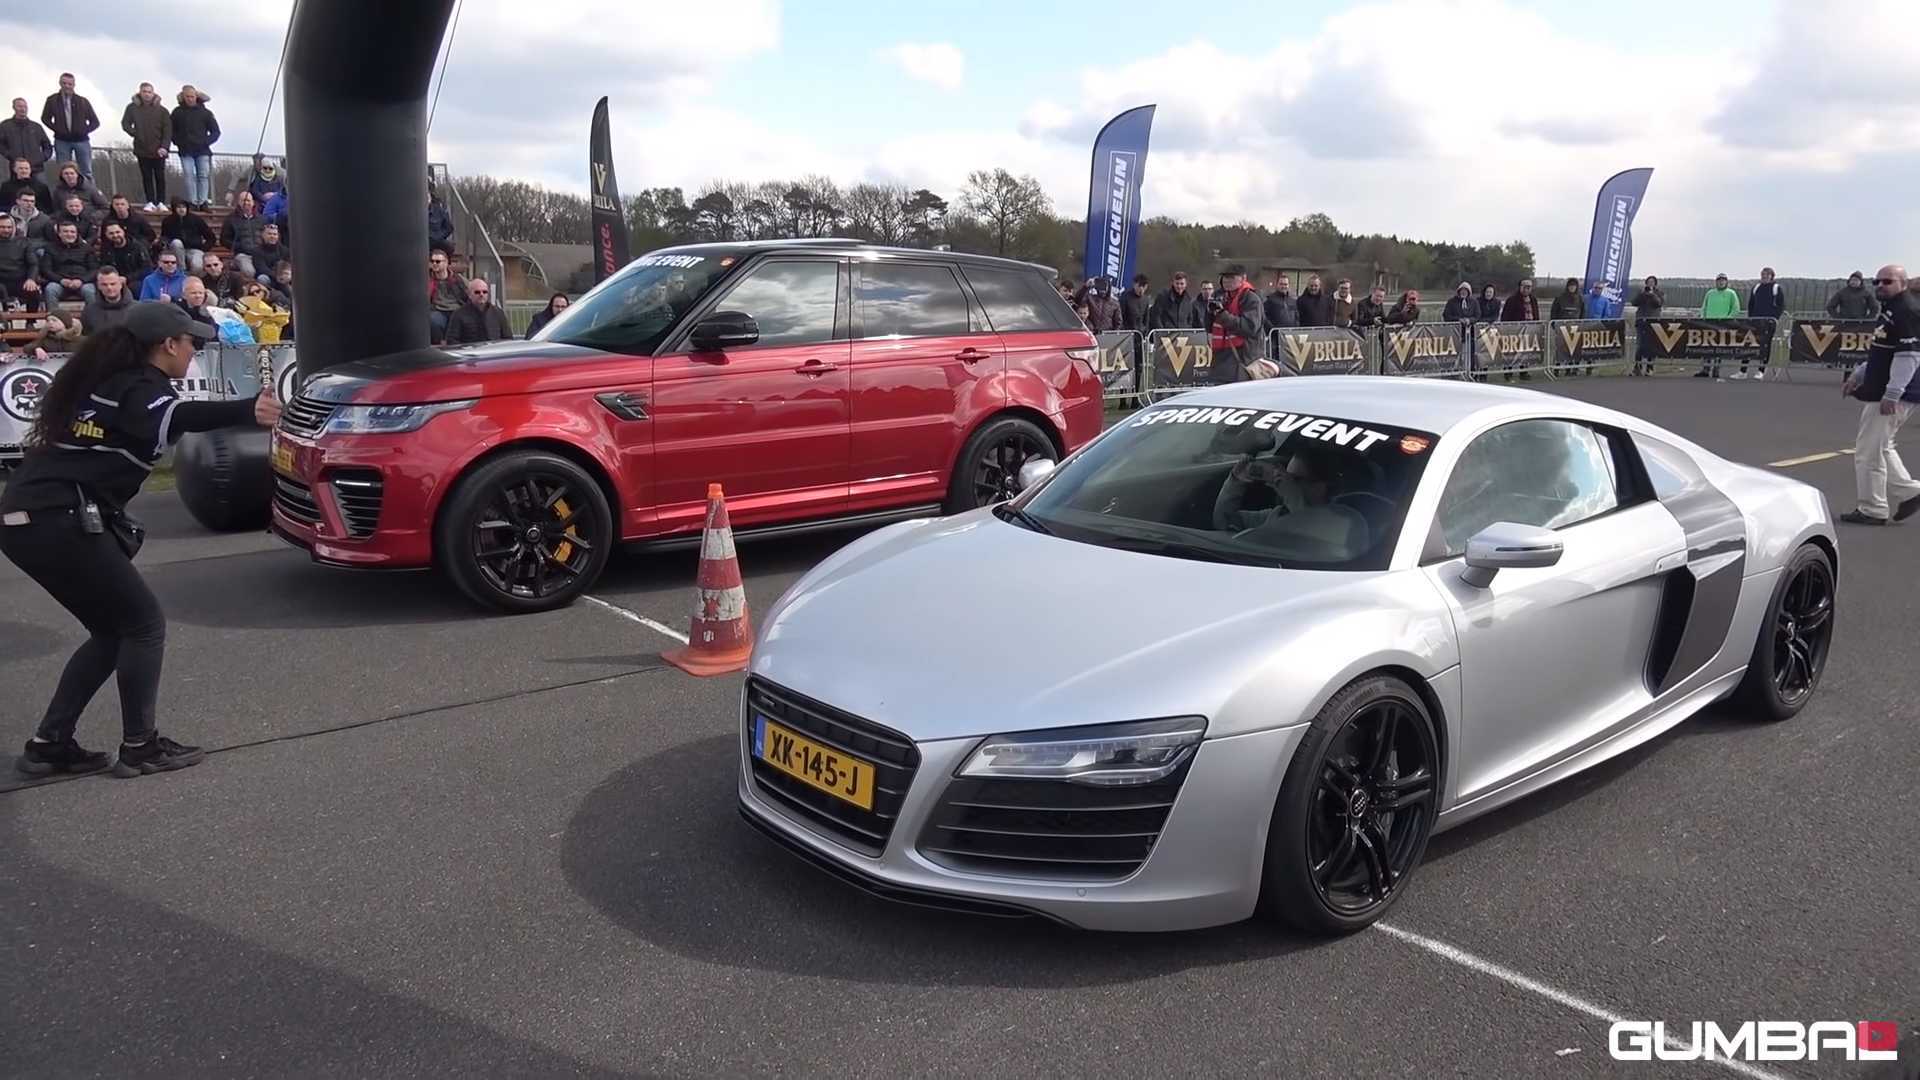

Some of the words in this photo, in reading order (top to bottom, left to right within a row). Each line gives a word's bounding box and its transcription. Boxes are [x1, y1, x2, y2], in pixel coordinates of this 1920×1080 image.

[1107, 157, 1127, 278] MICHELIN
[1606, 200, 1627, 282] MICHELIN
[1414, 336, 1457, 358] BRILA
[1501, 334, 1540, 353] BRILA
[1581, 330, 1621, 349] BRILA
[1686, 329, 1760, 347] BRILA
[1313, 340, 1363, 362] BRILA
[1132, 408, 1258, 428] SPRING
[1254, 412, 1389, 451] EVENT
[770, 730, 858, 796] XK-145-J
